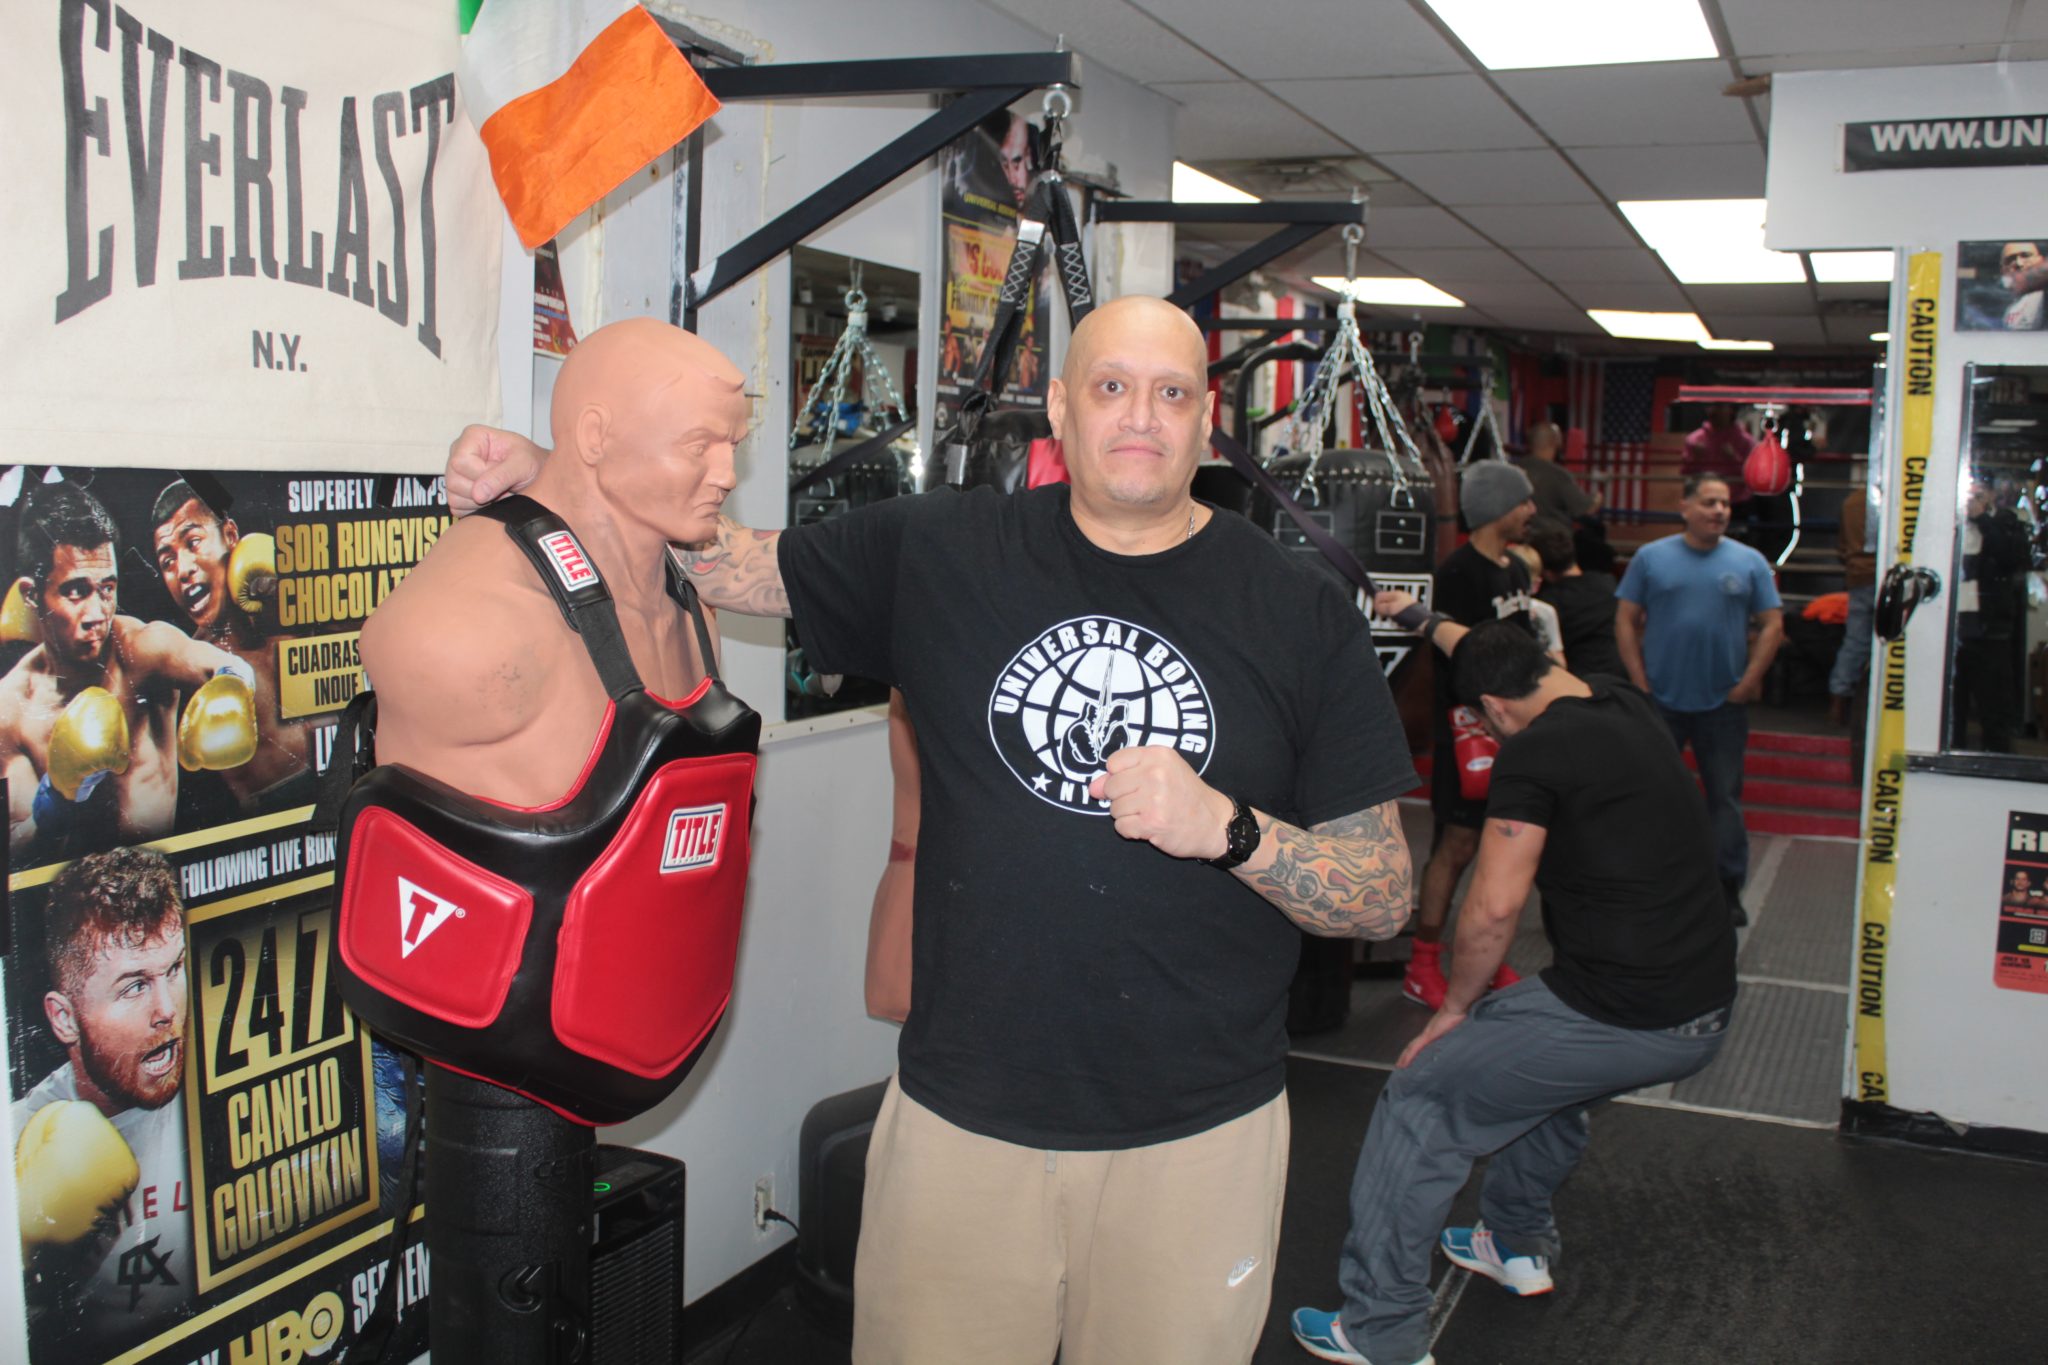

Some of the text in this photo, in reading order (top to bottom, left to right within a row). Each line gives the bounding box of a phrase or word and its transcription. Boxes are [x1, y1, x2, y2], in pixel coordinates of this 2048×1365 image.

[55, 0, 455, 360] EVERLAST
[252, 330, 307, 373] N.Y.
[1907, 298, 1935, 396] CAUTION
[288, 479, 374, 513] SUPERFLY
[276, 523, 329, 573] SOR
[551, 535, 591, 580] TITLE
[288, 639, 361, 675] CUADRAS
[994, 620, 1208, 754] UNIVERSAL BOXING
[1885, 635, 1905, 711] UTION
[672, 815, 721, 859] TITLE
[1869, 768, 1900, 864] CAUTION
[180, 831, 337, 899] FOLLOWING LIVE BOX
[1860, 922, 1885, 1018] CAUTION
[228, 1057, 341, 1170] CANELO
[212, 1127, 363, 1262] GOLOVKIN
[229, 1291, 344, 1365] HBO
